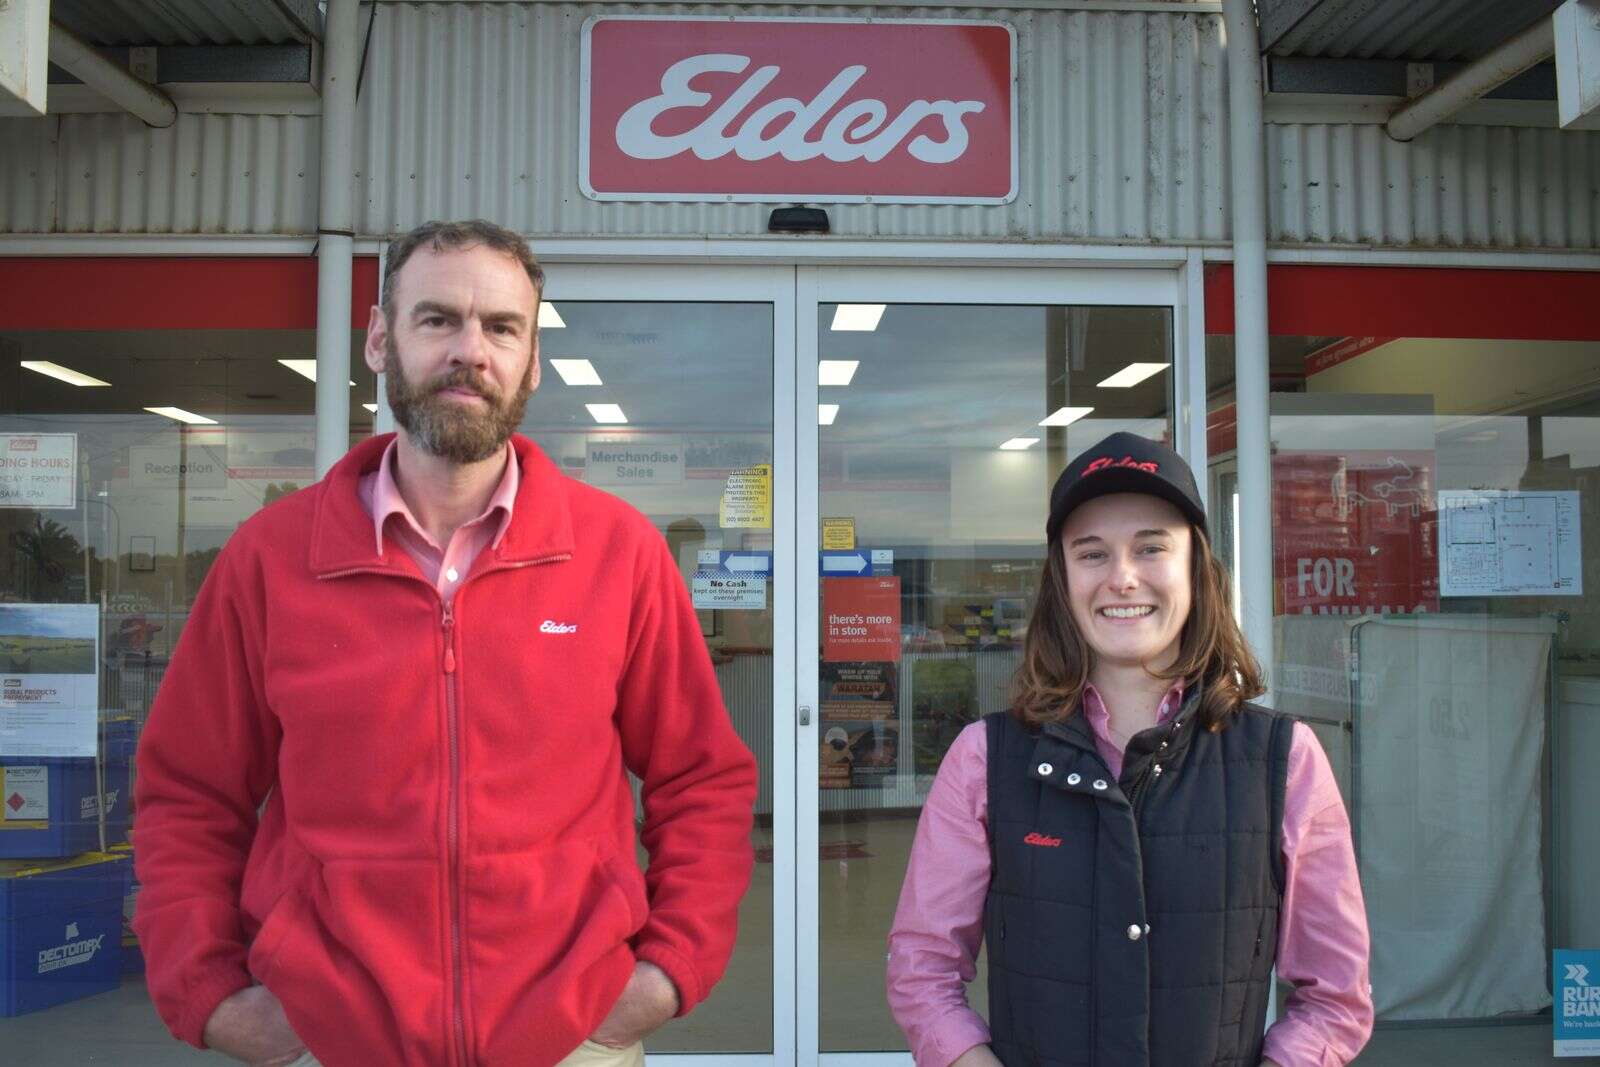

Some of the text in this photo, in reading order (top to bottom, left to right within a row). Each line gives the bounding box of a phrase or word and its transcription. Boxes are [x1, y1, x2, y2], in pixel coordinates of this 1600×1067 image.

[615, 53, 986, 164] Elders
[32, 458, 70, 468] HOURS
[592, 452, 678, 463] Merchandise
[144, 462, 213, 478] Reception
[616, 466, 654, 478] Sales
[1081, 456, 1158, 476] Elders
[1297, 557, 1356, 597] FOR
[829, 614, 893, 625] there's more
[540, 620, 578, 633] Elders
[829, 625, 867, 636] in store
[1023, 832, 1062, 847] Elders
